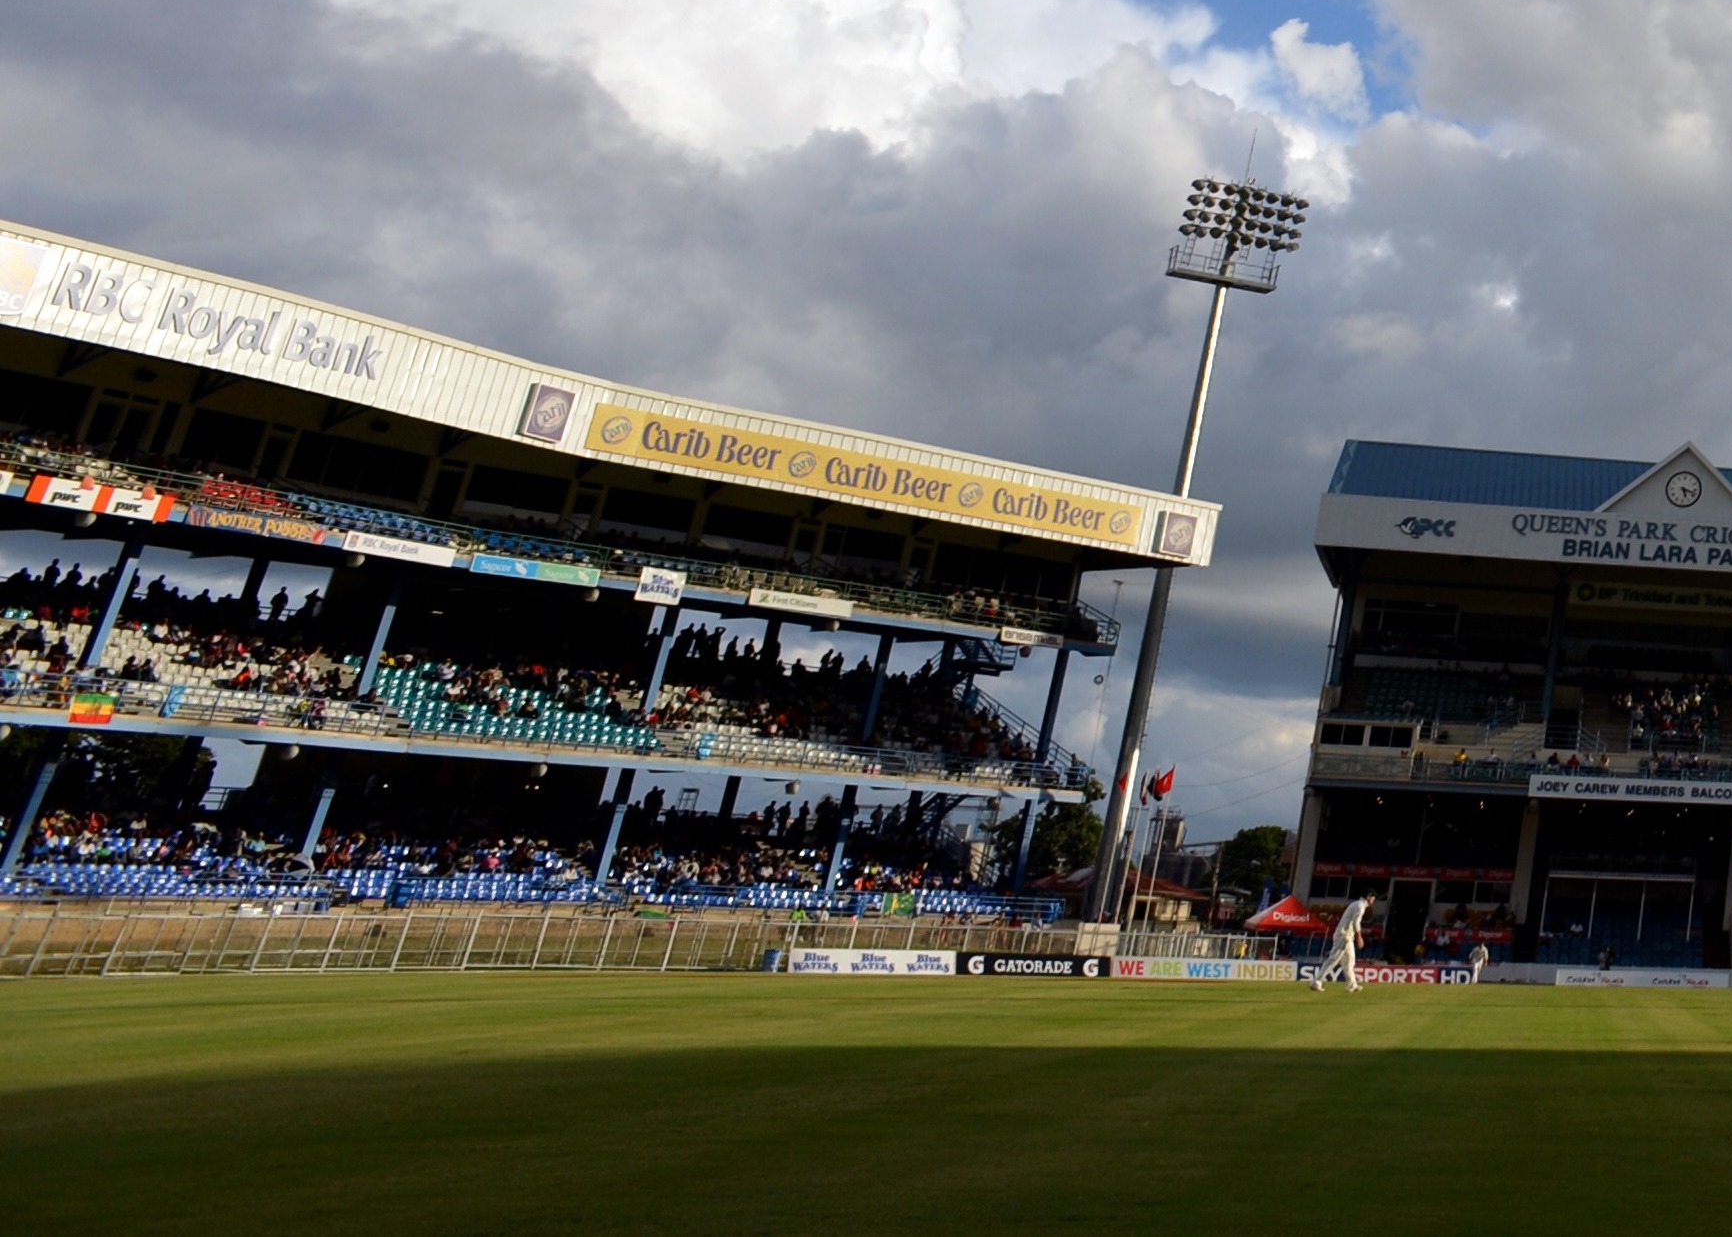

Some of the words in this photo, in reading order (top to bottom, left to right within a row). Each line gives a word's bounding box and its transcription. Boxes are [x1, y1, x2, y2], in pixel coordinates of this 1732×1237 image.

[0, 290, 24, 310] BC
[51, 262, 157, 324] RBC
[157, 287, 282, 355] Royal
[282, 318, 383, 380] Bank
[642, 421, 711, 459] Carib
[715, 434, 782, 470] Beer
[825, 456, 888, 492] Carib
[891, 468, 952, 502] Beer
[992, 487, 1048, 521] Carib
[1052, 498, 1105, 531] Beer
[1511, 513, 1607, 537] QUEEN'S
[1617, 520, 1677, 542] PARK
[1562, 538, 1630, 560] BRIAN
[1639, 543, 1698, 564] LARA
[1536, 781, 1569, 792] JOEY
[1574, 782, 1620, 794] CAREW
[1625, 784, 1685, 797] MEMBERS
[1273, 911, 1310, 923] Digicel
[804, 952, 830, 962] Blue
[861, 953, 887, 962] Blue
[916, 954, 941, 963] Blue
[792, 962, 838, 972] WATERS
[850, 962, 895, 973] WATERS
[907, 962, 950, 973] WATERS
[994, 959, 1073, 974] GATORADE
[1119, 960, 1144, 976] WE
[1151, 961, 1182, 976] ARE
[1187, 962, 1231, 978] WEST
[1237, 964, 1292, 979] INDIES
[1354, 968, 1434, 984] SPORTS
[1441, 969, 1471, 985] HD
